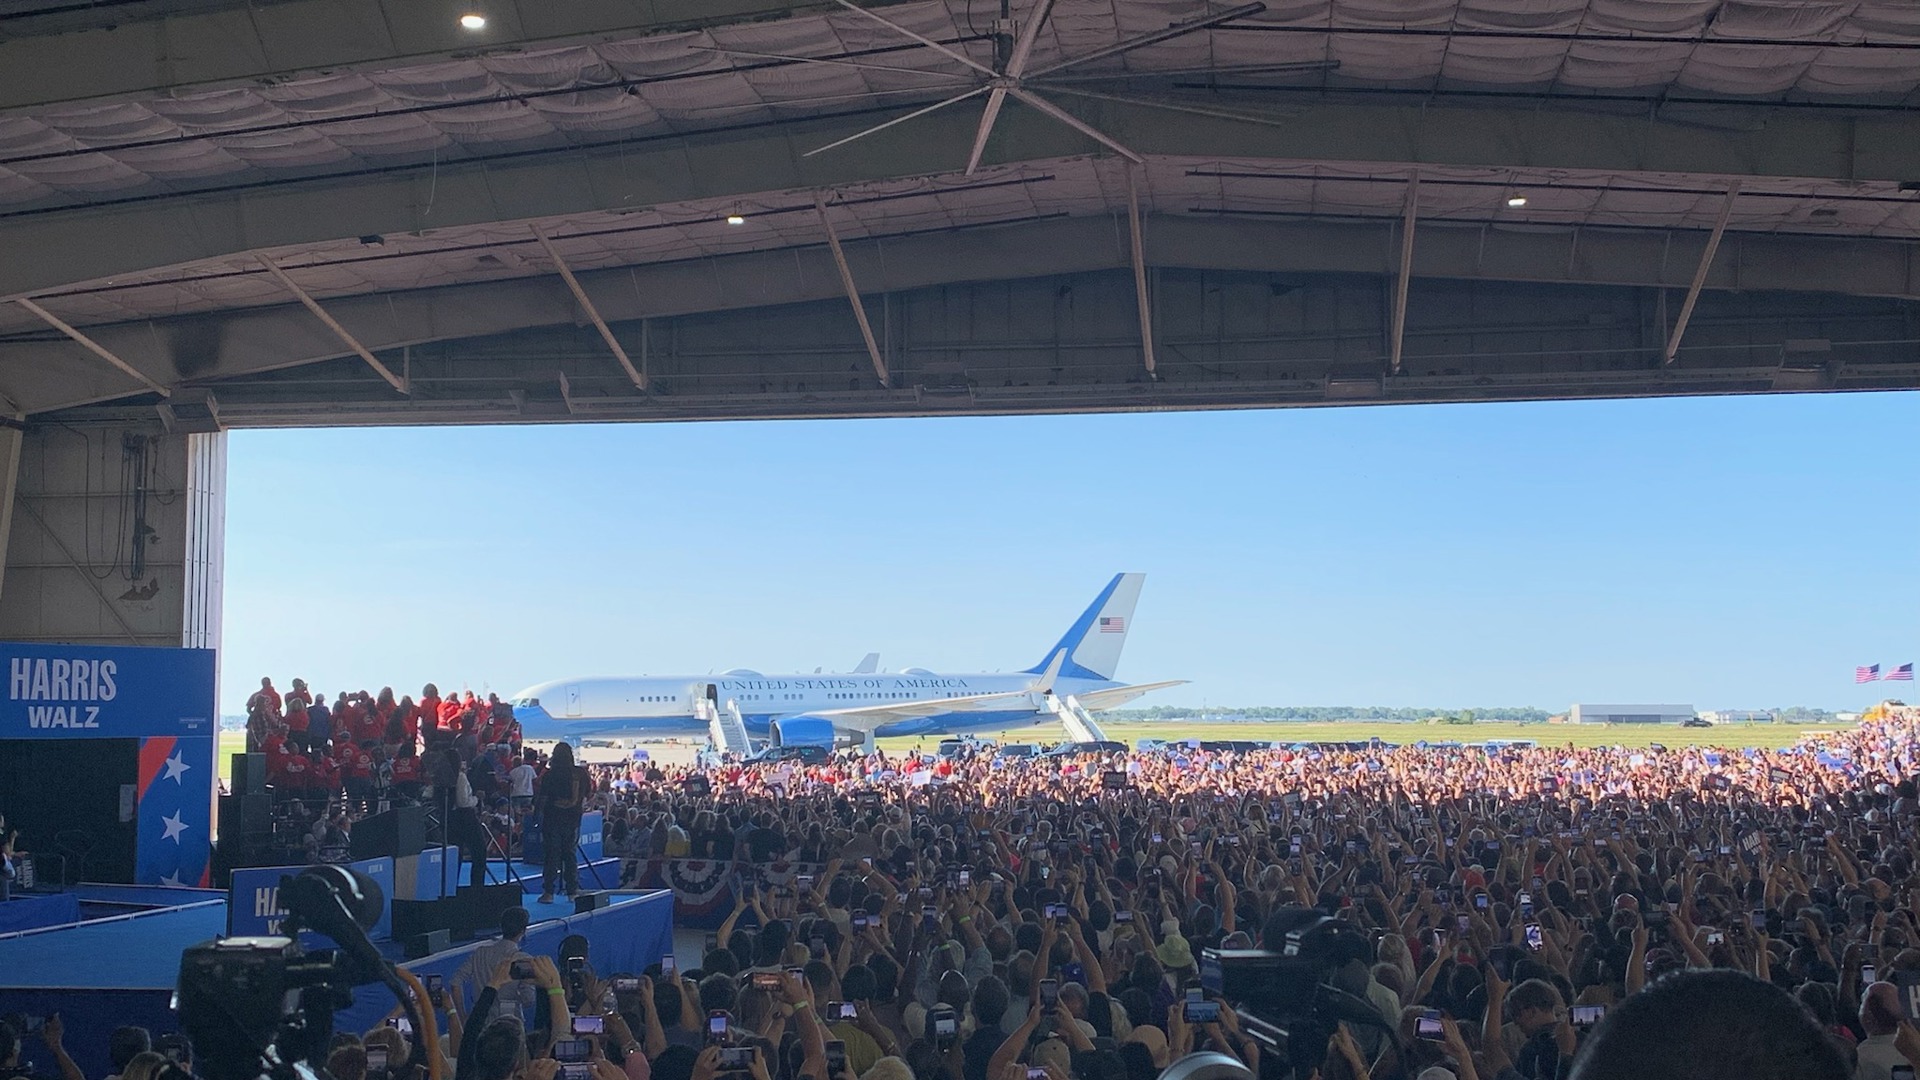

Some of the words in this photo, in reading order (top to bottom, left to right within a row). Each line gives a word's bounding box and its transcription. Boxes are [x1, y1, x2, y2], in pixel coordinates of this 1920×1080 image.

[10, 657, 117, 701] HARRIS
[721, 681, 787, 690] UNITED
[795, 680, 857, 689] STATES
[863, 679, 883, 688] OF
[894, 679, 968, 688] AMERICA
[28, 706, 99, 729] WALZ
